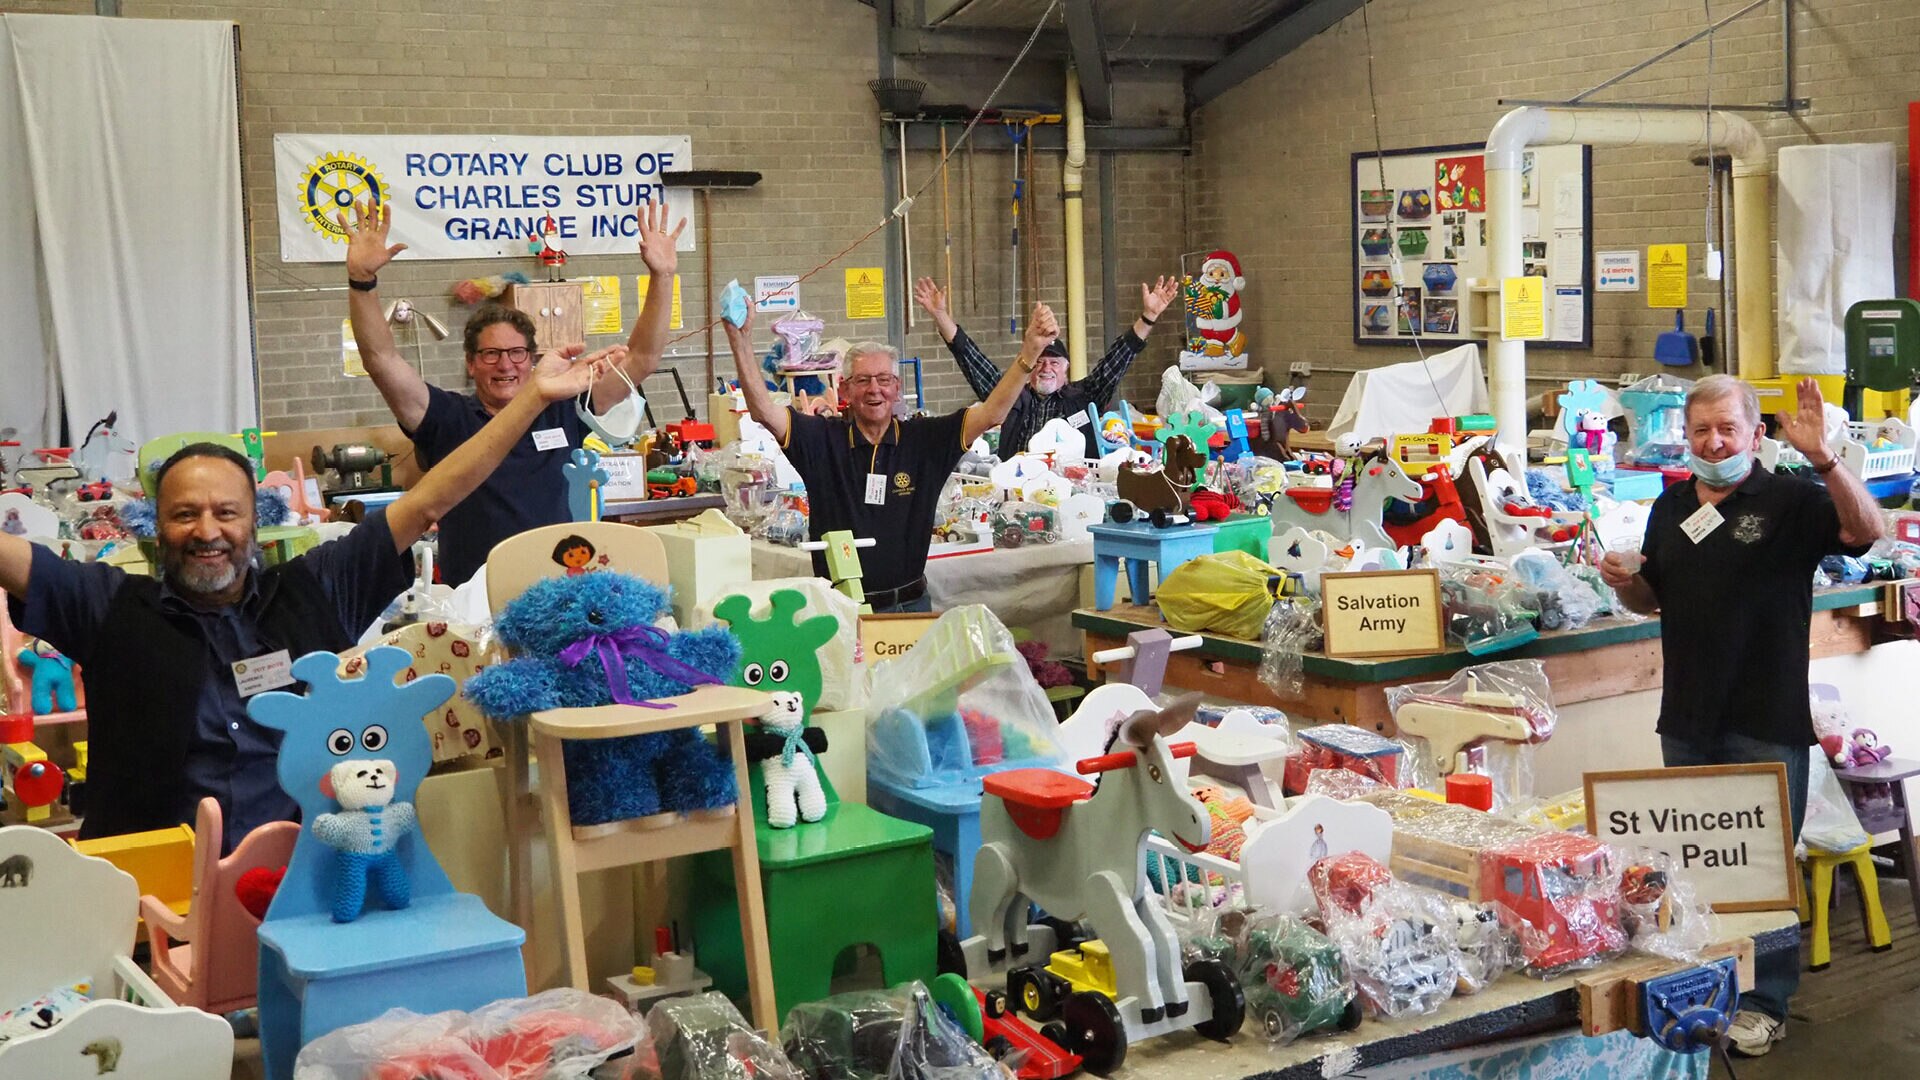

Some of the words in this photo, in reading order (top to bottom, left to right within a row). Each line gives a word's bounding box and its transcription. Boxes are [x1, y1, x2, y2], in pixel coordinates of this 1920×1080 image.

[325, 162, 359, 172] ROTARY
[406, 153, 529, 177] ROTARY
[544, 153, 622, 177] CLUB
[635, 152, 674, 176] OF
[414, 184, 561, 210] CHARLES
[576, 183, 665, 207] STURT
[592, 213, 639, 238] INC
[1337, 593, 1420, 611] Salvation
[1359, 616, 1406, 634] Army
[874, 639, 918, 656] Care
[1609, 810, 1641, 836] St
[1648, 804, 1766, 834] Vincent
[1681, 841, 1749, 869] Paul
